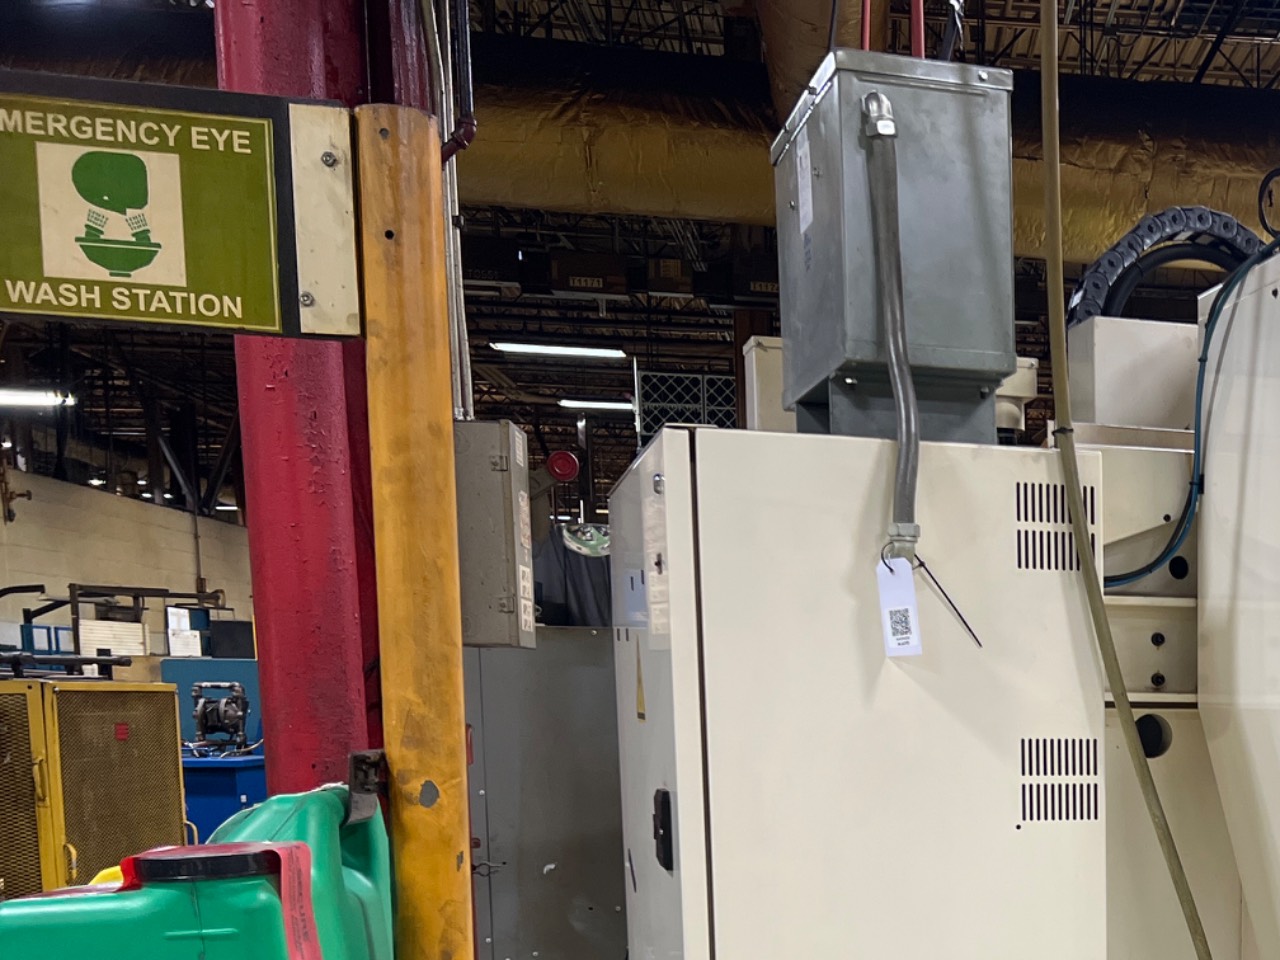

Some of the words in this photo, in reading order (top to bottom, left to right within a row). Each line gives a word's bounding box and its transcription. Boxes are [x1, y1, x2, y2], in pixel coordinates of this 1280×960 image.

[0, 108, 182, 147] MERGENCY
[191, 126, 252, 154] EYE
[5, 279, 101, 308] WASH
[112, 288, 243, 319] STATION
